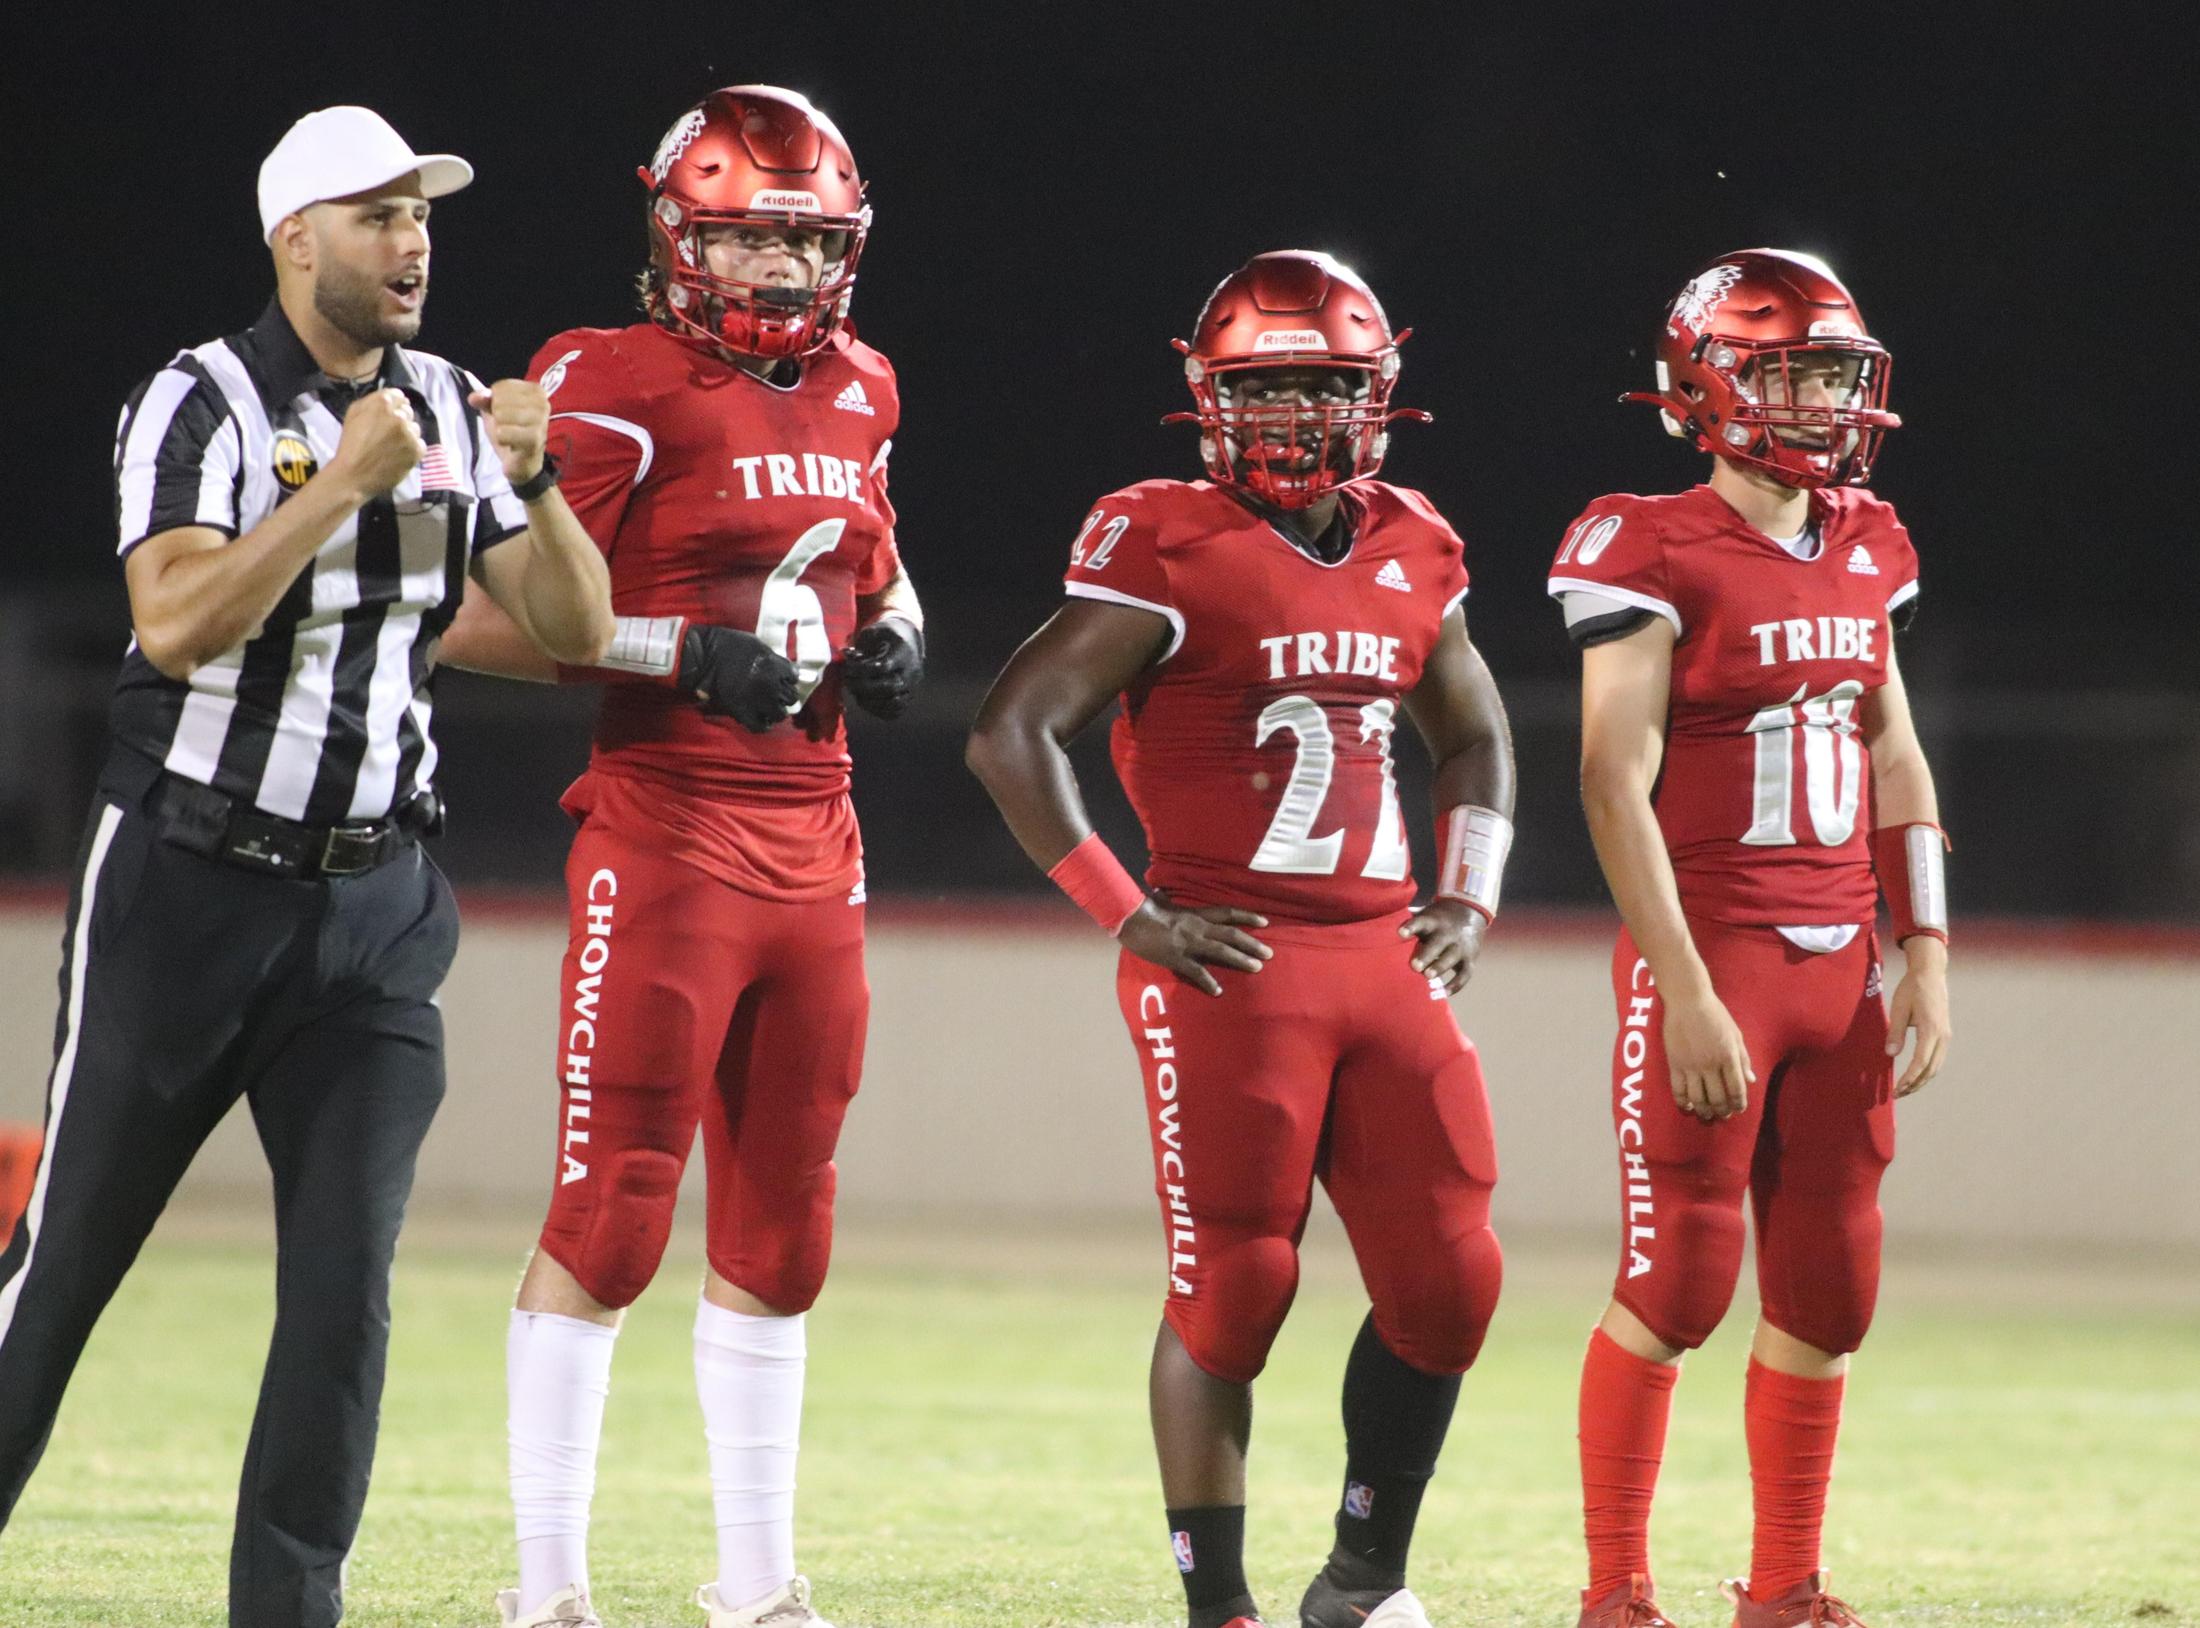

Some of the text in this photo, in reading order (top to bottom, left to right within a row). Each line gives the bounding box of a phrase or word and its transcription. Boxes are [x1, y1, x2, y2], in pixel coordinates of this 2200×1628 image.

[1264, 333, 1317, 345] Riddell
[732, 452, 866, 506] TRIBE
[1070, 509, 1130, 571] 22
[1556, 513, 1623, 566] 10
[755, 517, 847, 714] 6
[1750, 616, 1877, 666] TRIBE
[1259, 631, 1401, 682] TRIBE
[1738, 679, 1865, 847] 10
[561, 868, 617, 1186] CHOWCHILLA
[1140, 984, 1197, 1295] CHOWCHILLA
[1619, 957, 1656, 1280] CHOWCHILLA
